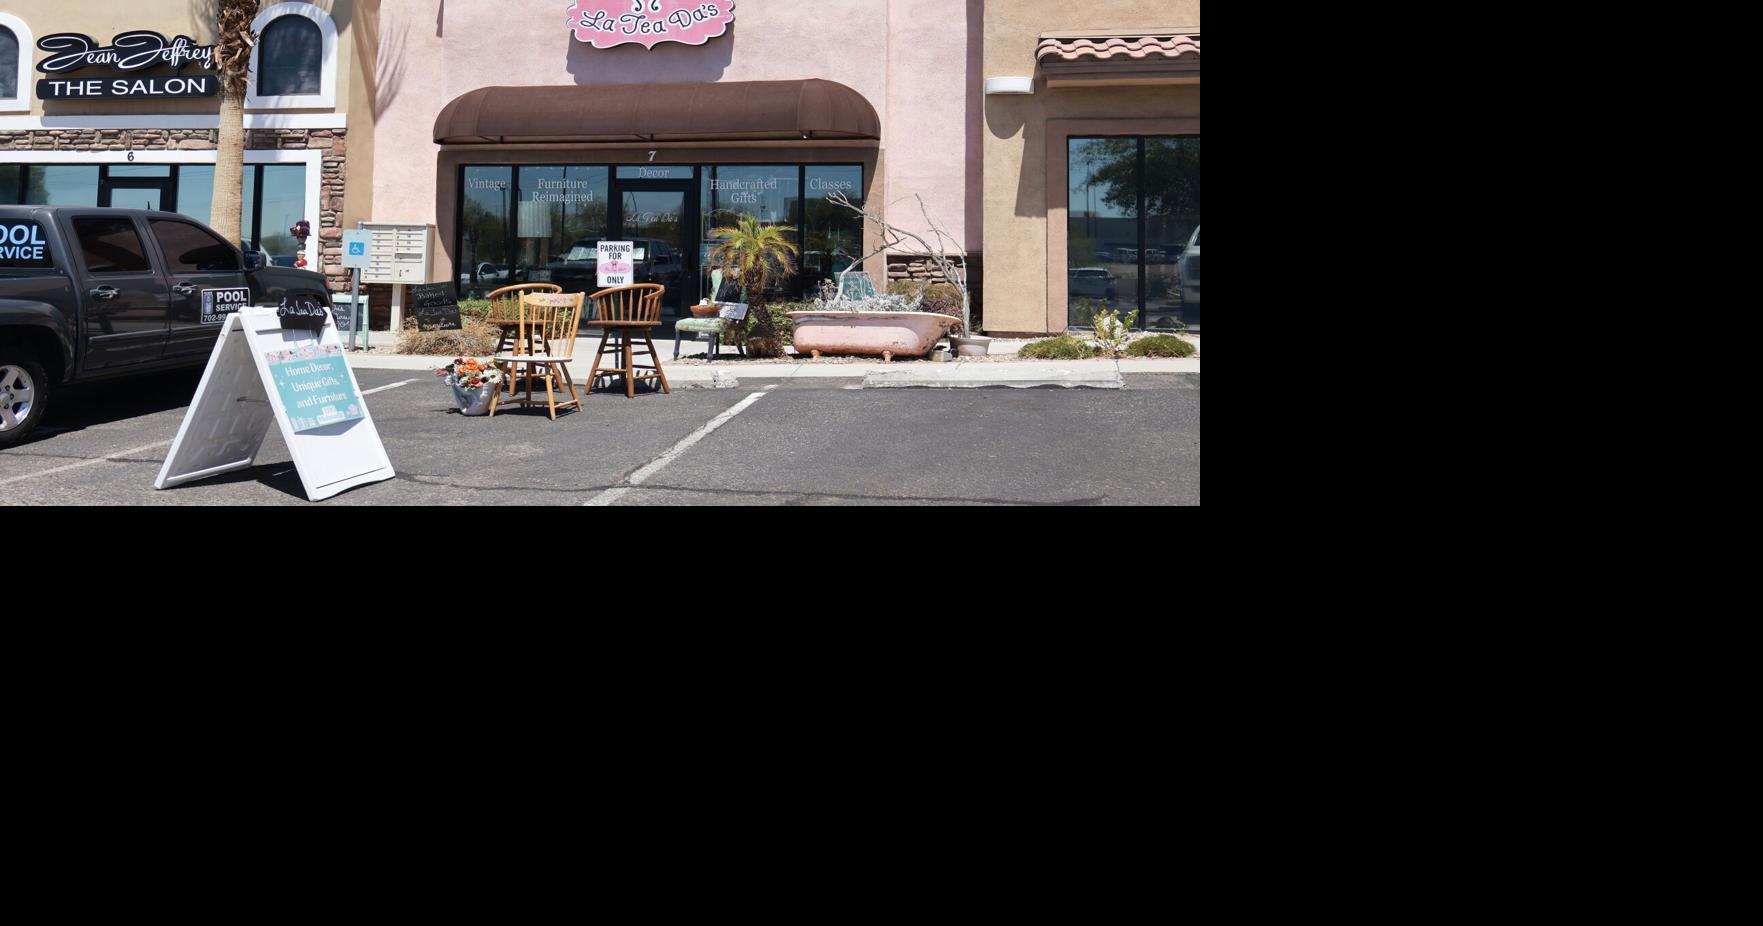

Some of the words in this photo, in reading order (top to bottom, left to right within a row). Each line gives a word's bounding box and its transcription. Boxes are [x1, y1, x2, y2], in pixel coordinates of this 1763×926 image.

[580, 10, 615, 31] La
[620, 14, 667, 35] Tea
[668, 4, 719, 28] Da's
[40, 35, 121, 71] Jean
[114, 33, 212, 70] Jeffrey
[48, 80, 103, 96] THE
[111, 78, 206, 95] SALON
[127, 151, 135, 162] 6
[647, 150, 657, 162] 7
[639, 166, 670, 178] Decor
[468, 177, 507, 192] Vintage
[537, 178, 588, 189] Furniture
[710, 177, 778, 190] Handcrafted
[809, 177, 852, 190] Classes
[532, 190, 594, 204] Reimagined
[730, 191, 758, 204] Gifts
[600, 244, 630, 252] PARKING
[608, 252, 621, 260] FOR
[606, 275, 624, 284] ONLY
[216, 290, 247, 302] POOL
[285, 366, 311, 377] Home
[291, 379, 321, 393] Unique
[296, 397, 314, 409] and
[313, 392, 347, 405] Furniture
